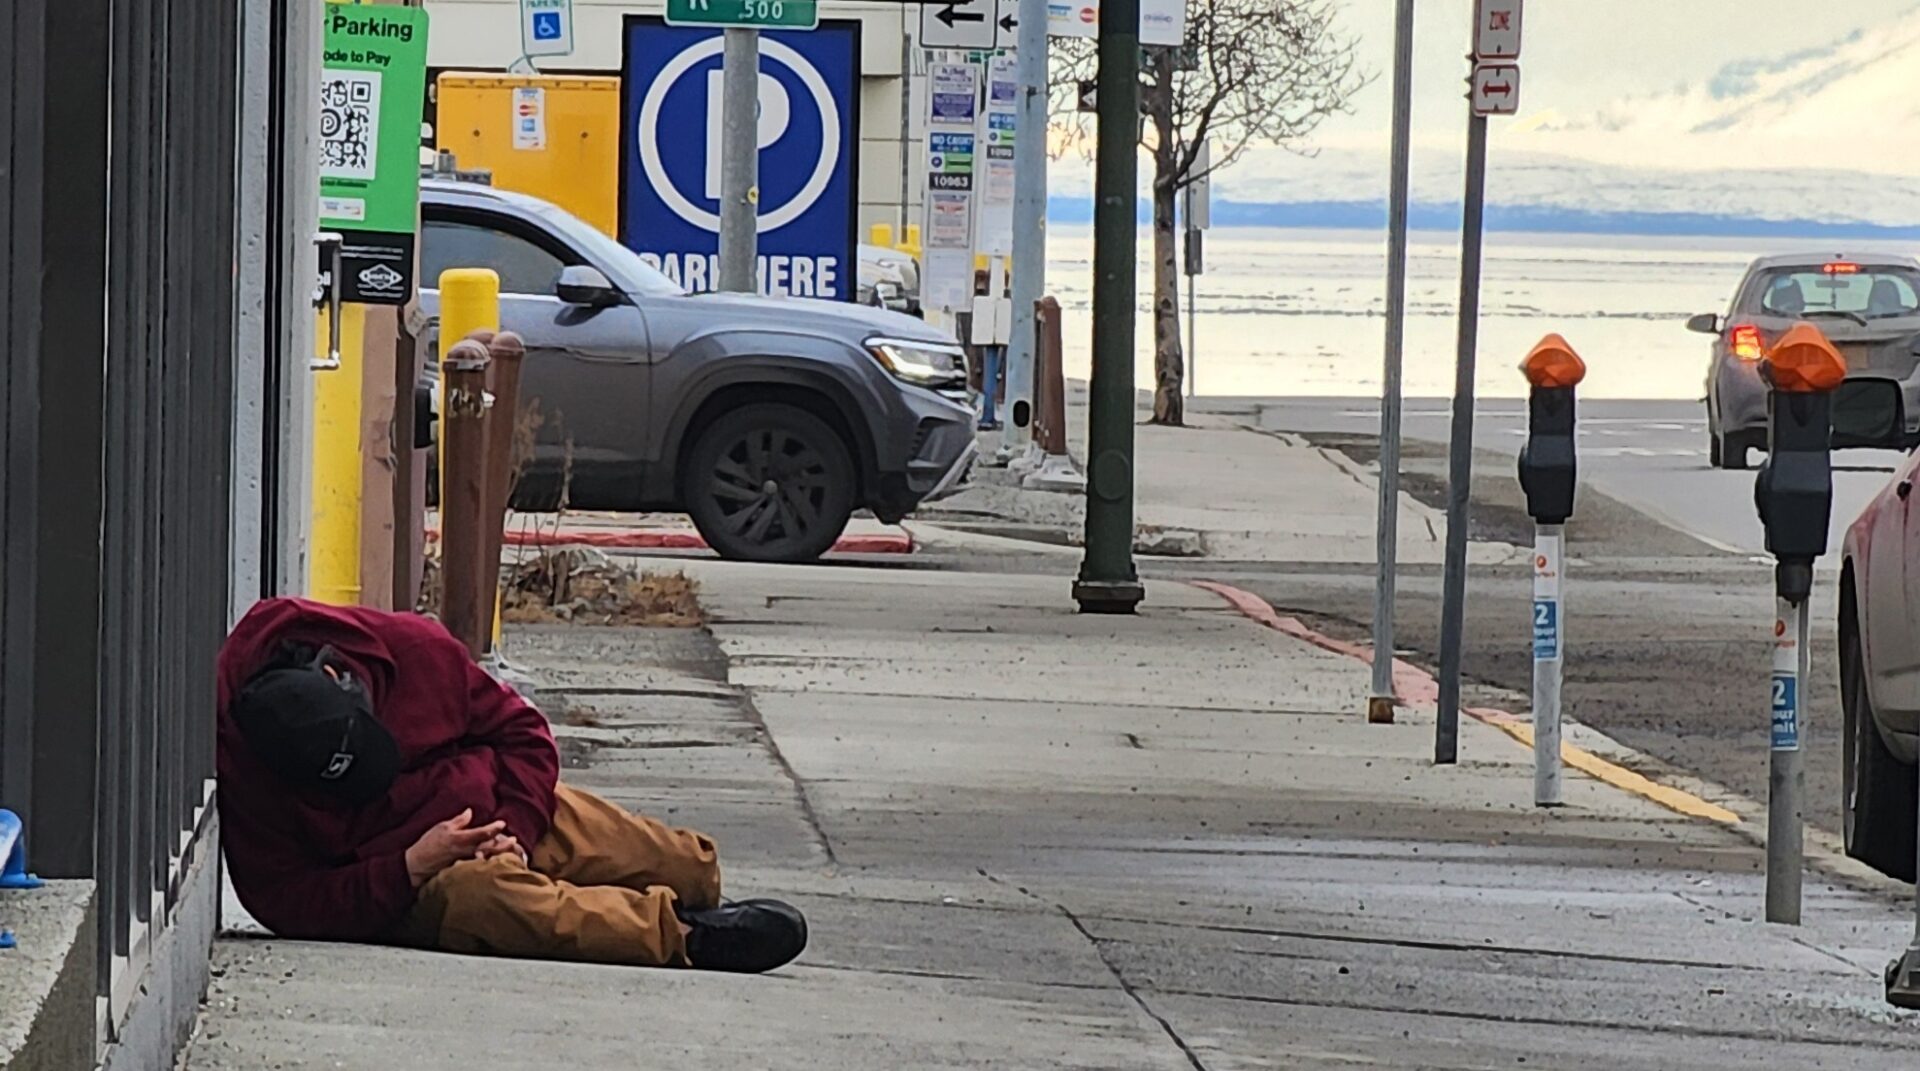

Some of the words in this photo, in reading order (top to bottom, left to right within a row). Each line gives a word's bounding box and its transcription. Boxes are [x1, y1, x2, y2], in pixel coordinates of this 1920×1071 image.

[333, 15, 413, 42] Parking
[323, 49, 348, 62] ode
[351, 50, 364, 63] to
[366, 50, 391, 67] Pay
[706, 69, 790, 199] P
[1535, 603, 1549, 625] 2
[1773, 680, 1786, 706] 2
[1773, 710, 1794, 720] our
